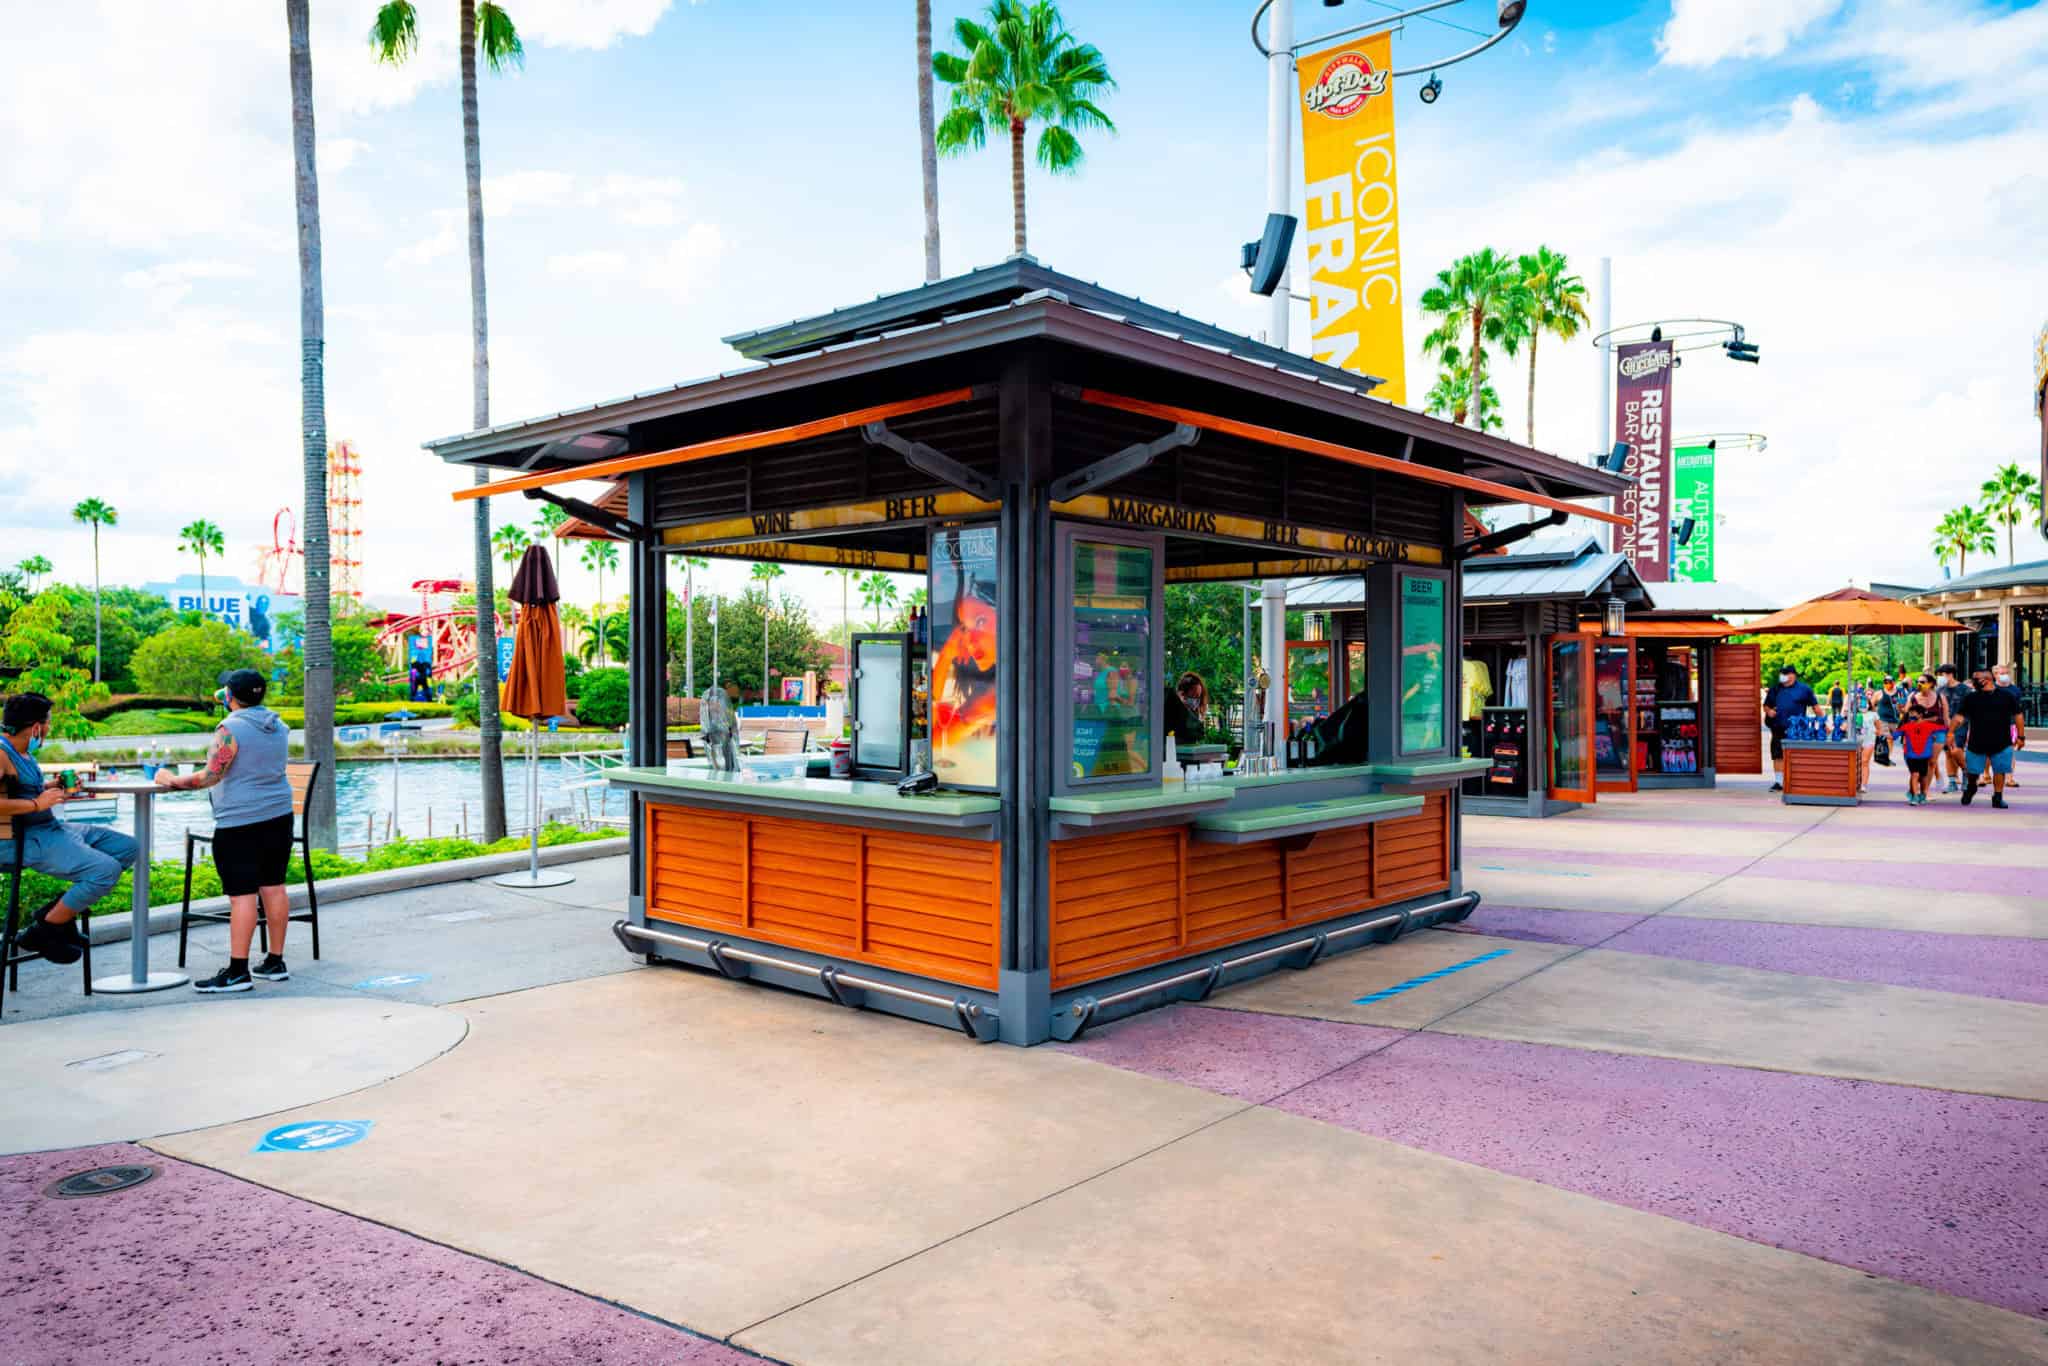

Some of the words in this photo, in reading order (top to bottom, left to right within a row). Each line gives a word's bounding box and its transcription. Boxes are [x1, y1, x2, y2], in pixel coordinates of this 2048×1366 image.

[1353, 132, 1398, 311] ICONIC
[1304, 172, 1362, 373] FRAN
[1625, 400, 1639, 435] BAR
[1637, 389, 1663, 564] RESTAURANT
[752, 511, 796, 535] WINE
[886, 495, 937, 521] BEER
[1107, 499, 1216, 534] MARGARITAS
[1264, 521, 1298, 545] BEER
[1344, 534, 1408, 560] COCKTAILS
[1675, 498, 1693, 582] MICA
[1694, 480, 1709, 570] AUTHENTIC
[178, 596, 241, 612] BLUE
[1411, 580, 1432, 593] BEER
